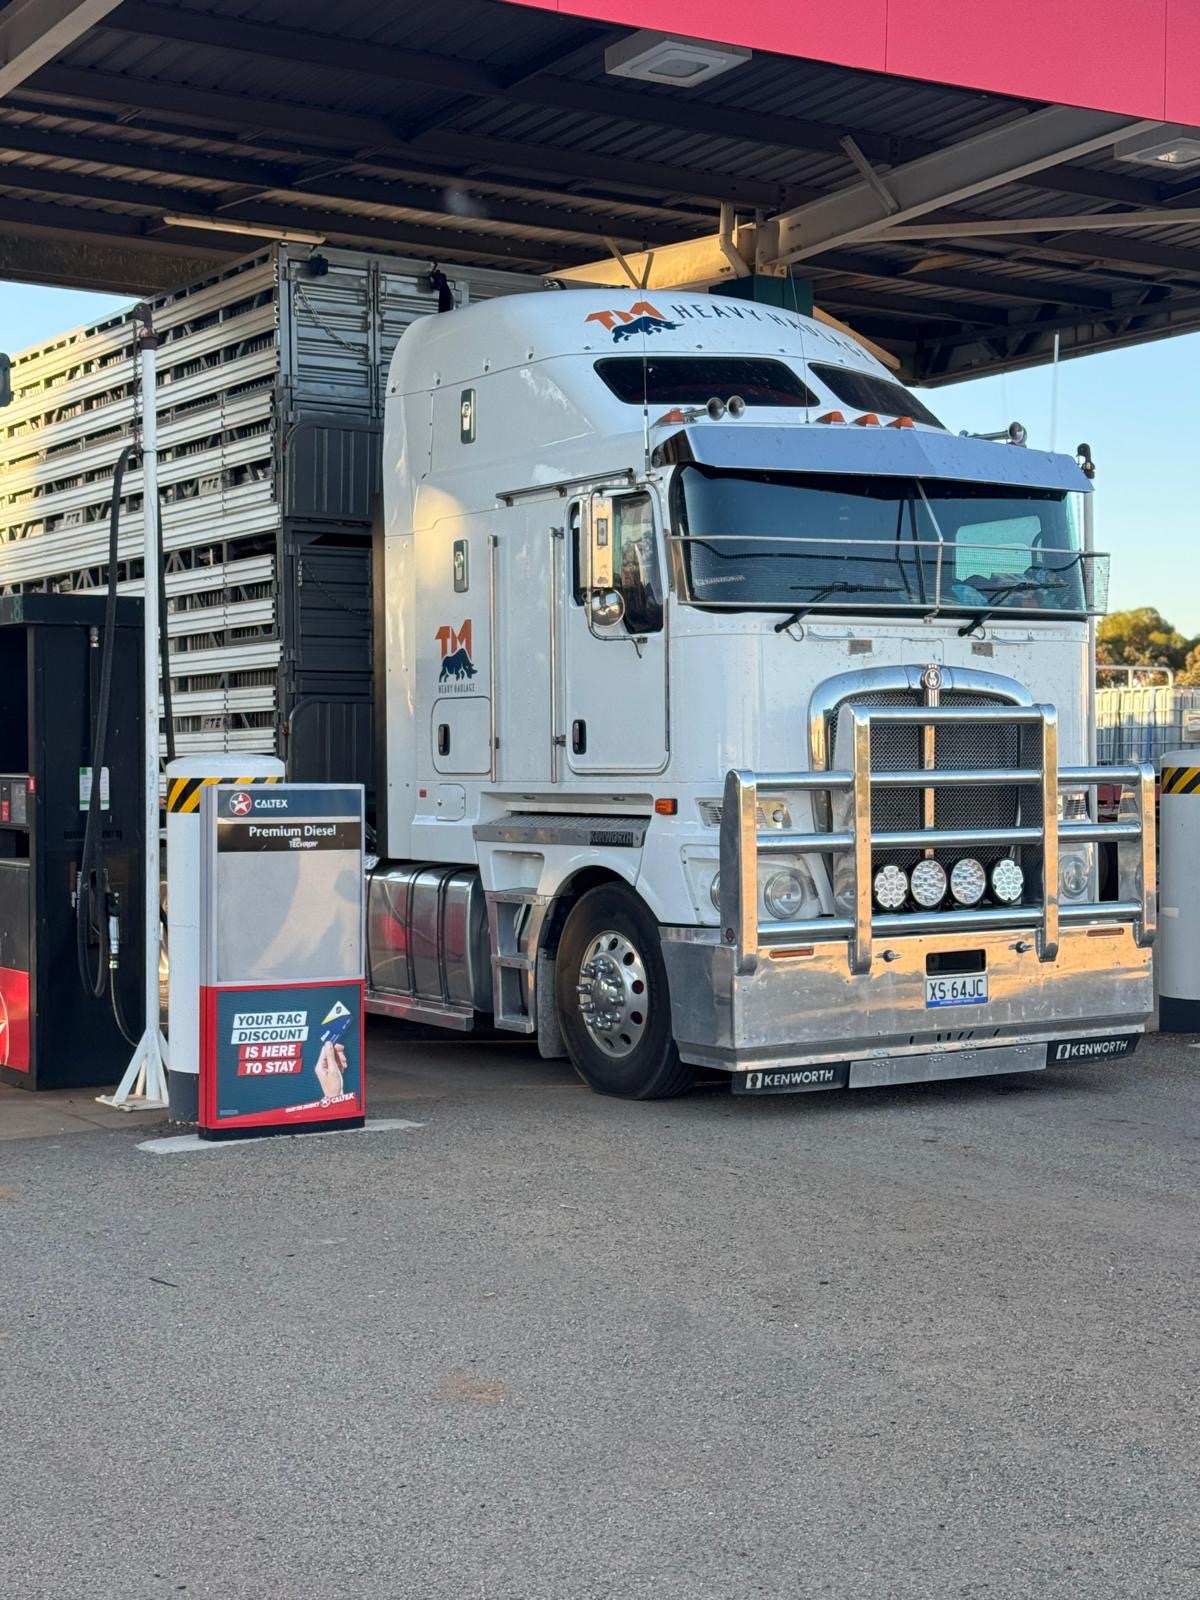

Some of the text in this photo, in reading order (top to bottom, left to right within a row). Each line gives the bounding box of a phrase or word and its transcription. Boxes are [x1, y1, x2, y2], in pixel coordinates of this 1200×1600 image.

[671, 304, 876, 365] HEAVY HAULAGE
[434, 618, 472, 661] TM
[438, 683, 475, 694] HEAVY HAULAGE
[254, 799, 289, 809] CALTEX
[249, 824, 337, 837] Premium Diesel
[237, 1013, 303, 1026] YOUR RAC
[238, 1029, 304, 1042] DISCOUNT
[245, 1044, 297, 1058] IS HERE
[1071, 1040, 1129, 1056] KENWORTH
[245, 1060, 297, 1074] TO STAY
[764, 1069, 835, 1086] KENWORTH
[331, 1092, 355, 1104] CALTEX
